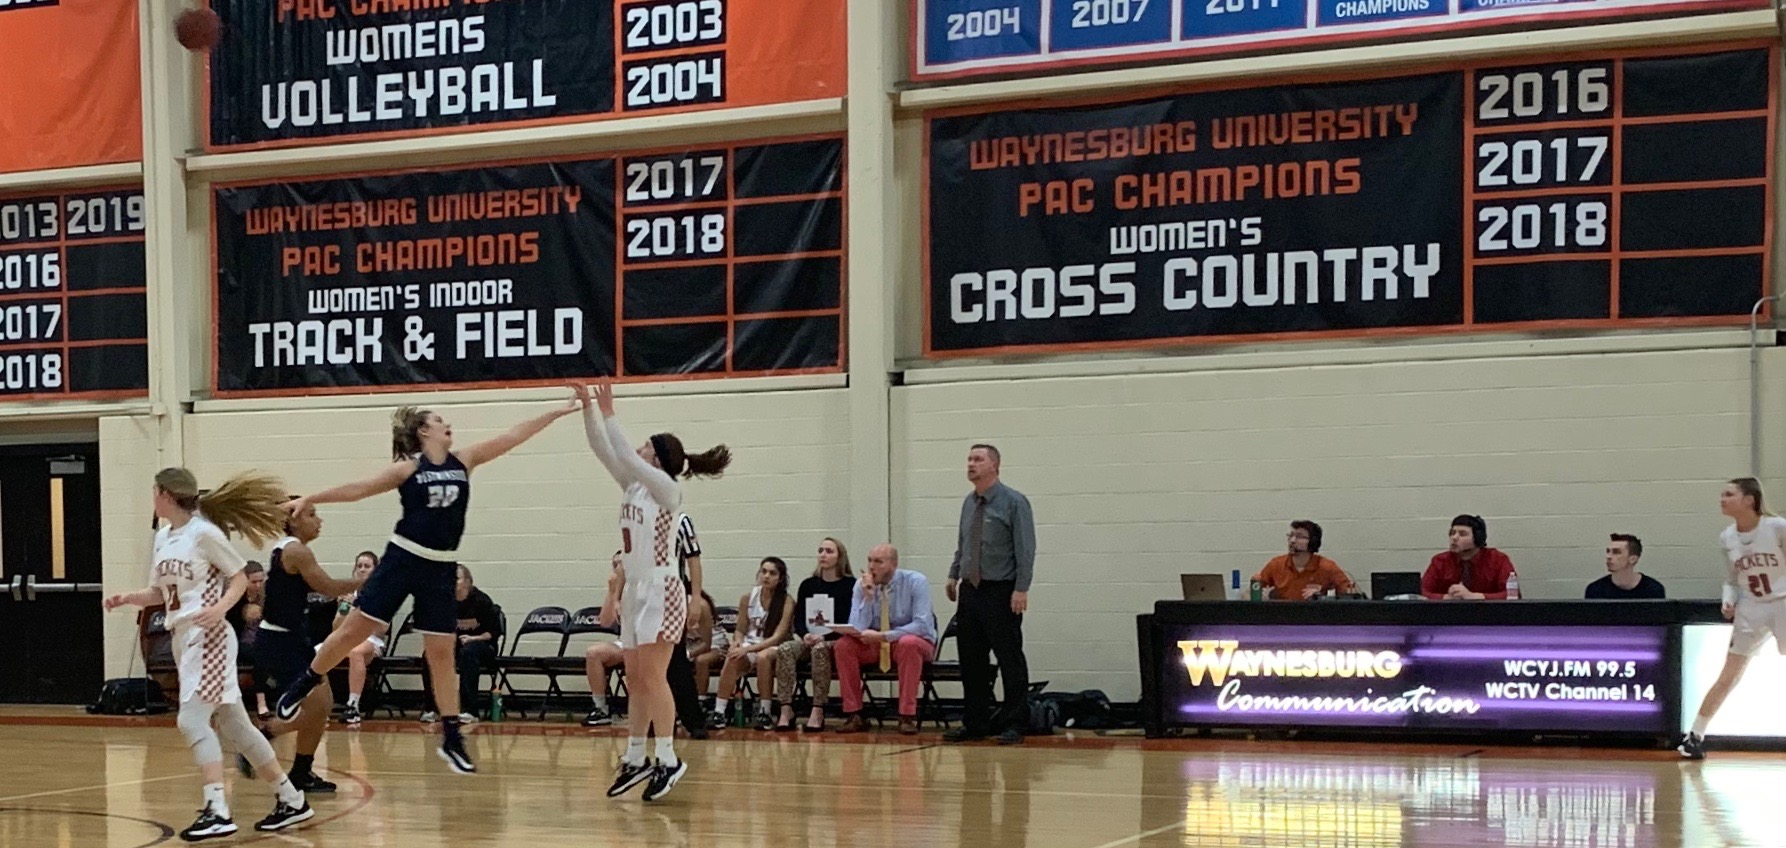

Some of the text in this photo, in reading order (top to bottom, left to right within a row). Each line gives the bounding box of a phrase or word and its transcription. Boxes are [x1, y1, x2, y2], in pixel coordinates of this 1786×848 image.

[627, 0, 722, 47] 2003
[947, 7, 1020, 41] 2004
[1072, 0, 1148, 28] 2007
[326, 15, 485, 66] WOMENS
[262, 59, 556, 129] VOLLEYBALL
[628, 58, 721, 106] 2004
[1479, 68, 1608, 119] 2016
[970, 102, 1418, 170] WAYNESBURG UNIVERSITY
[627, 156, 723, 201] 2017
[1478, 136, 1608, 187] 2017
[1019, 158, 1361, 217] PAC CHAMPIONS
[0, 202, 58, 239] 013
[67, 196, 145, 234] 2019
[246, 186, 581, 235] WAYNESBURG UNIVERSITY
[1478, 201, 1607, 251] 2018
[283, 232, 539, 277] PAC CHAMPIONS
[627, 214, 724, 257] 2018
[1110, 217, 1262, 255] WOMEN'S
[0, 253, 61, 289] 016
[950, 243, 1440, 324] CROSS COUNTRY
[308, 279, 513, 315] WOMEN'S INDOOR
[249, 307, 583, 367] TRACK & FIELD
[1748, 573, 1772, 597] 21
[1177, 640, 1402, 686] WAYNESBURG
[1596, 661, 1636, 677] 99.5
[1216, 679, 1481, 714] Communication
[1485, 682, 1655, 700] WCTV Channel 14
